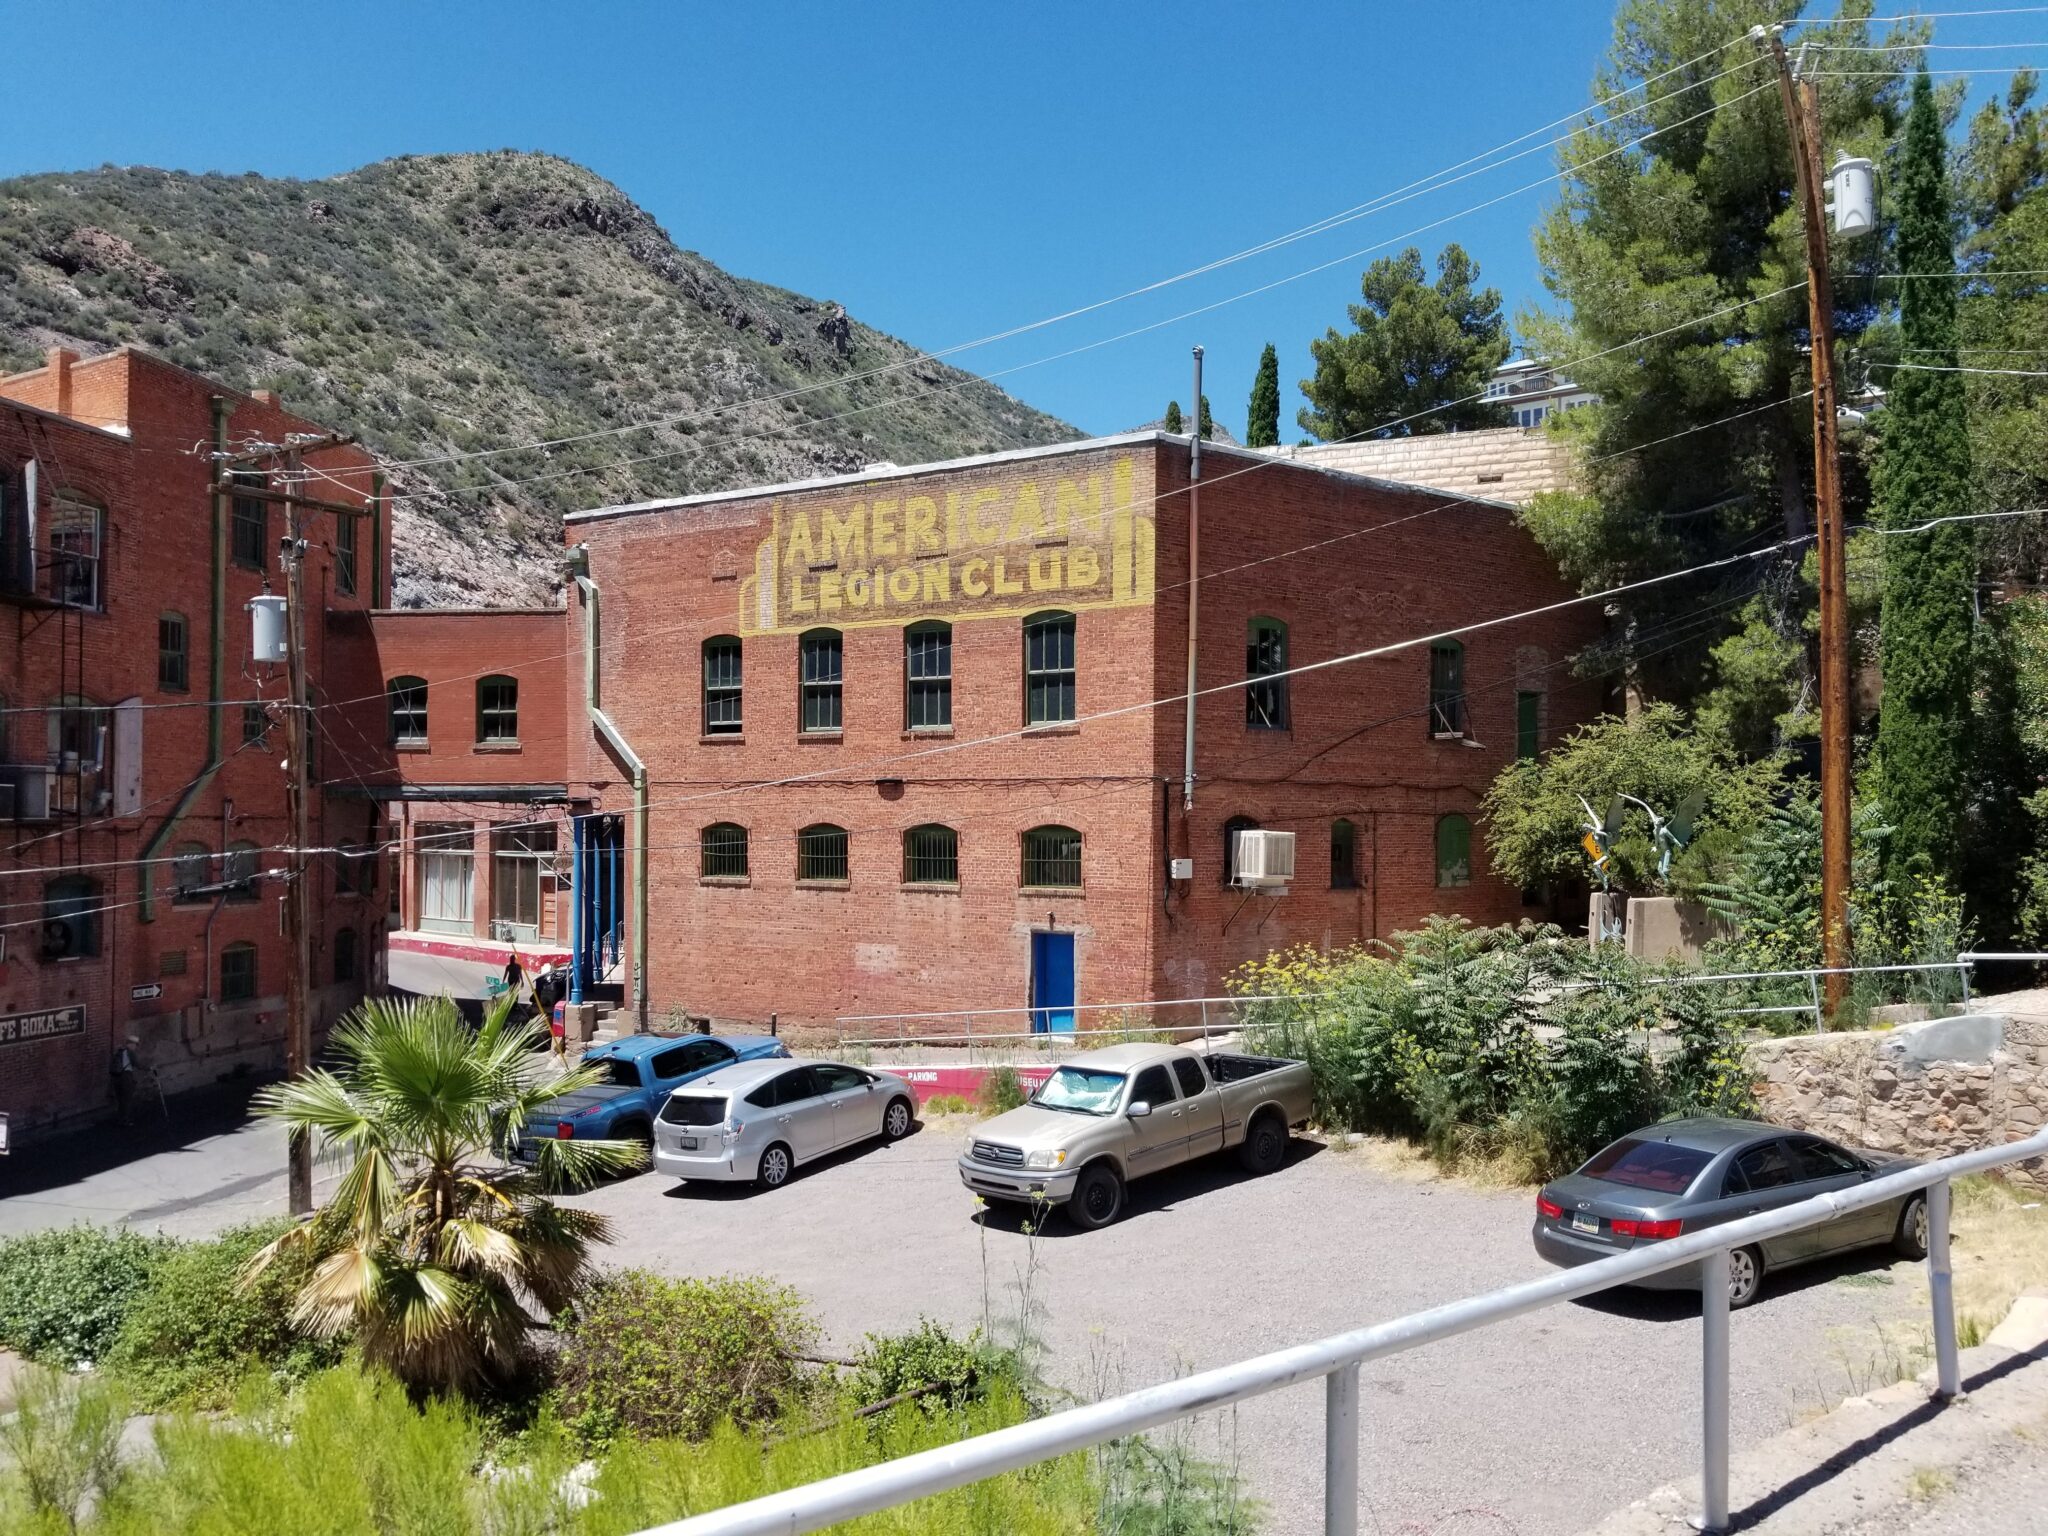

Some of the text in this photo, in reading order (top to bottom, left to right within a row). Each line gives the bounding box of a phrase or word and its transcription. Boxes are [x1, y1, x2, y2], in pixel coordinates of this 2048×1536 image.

[784, 474, 1102, 566] AMERICAN
[790, 546, 1102, 612] LEGION CLUB
[907, 1071, 938, 1082] PARKING
